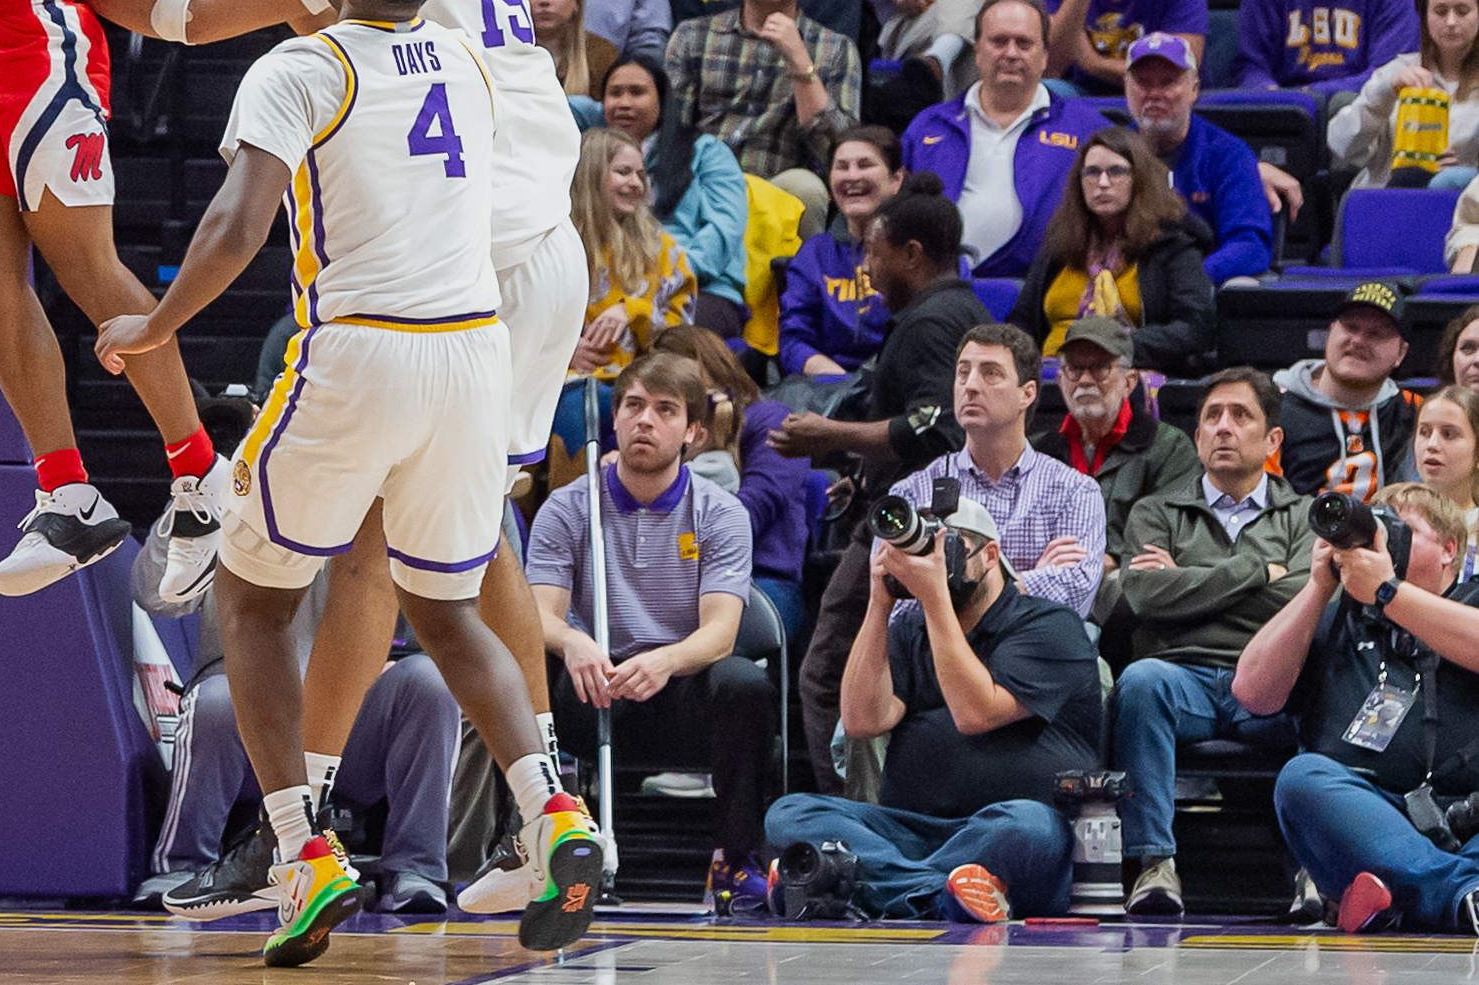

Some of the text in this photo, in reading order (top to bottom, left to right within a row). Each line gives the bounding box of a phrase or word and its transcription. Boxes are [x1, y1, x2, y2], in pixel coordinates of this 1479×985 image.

[1286, 7, 1360, 48] LSU
[391, 41, 442, 75] DAYS
[407, 83, 466, 178] 4
[1040, 130, 1077, 149] LSU
